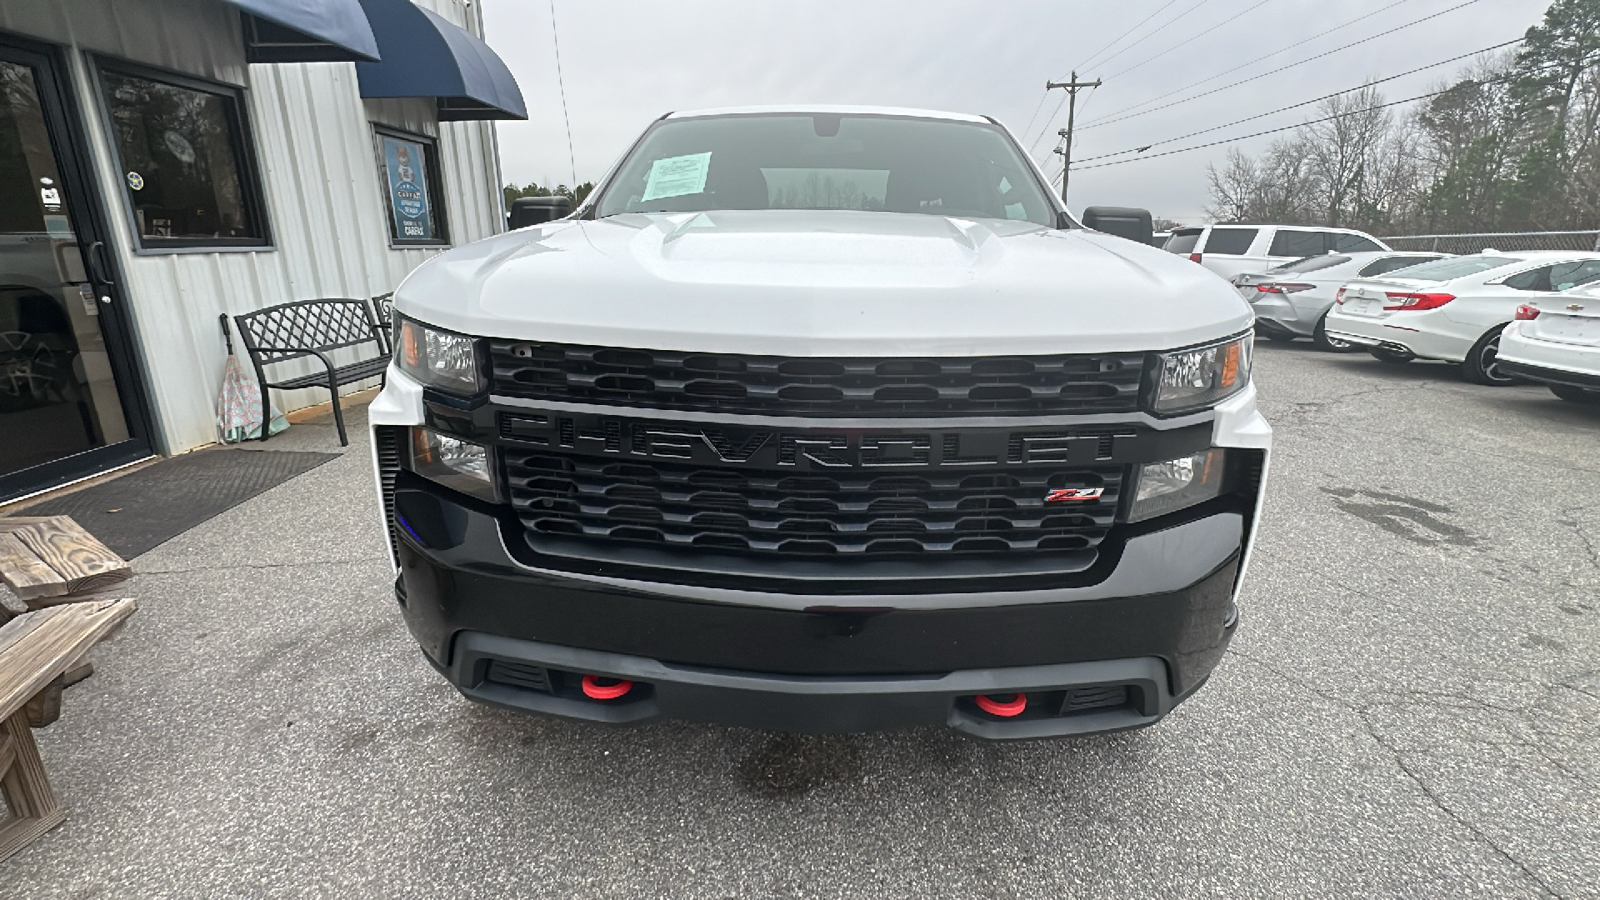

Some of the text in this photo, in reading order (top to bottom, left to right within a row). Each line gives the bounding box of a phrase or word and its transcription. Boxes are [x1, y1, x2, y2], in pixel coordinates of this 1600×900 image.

[405, 226, 424, 235] CARFAX
[499, 410, 1137, 466] CHEVROLET
[1044, 487, 1105, 502] Z71
